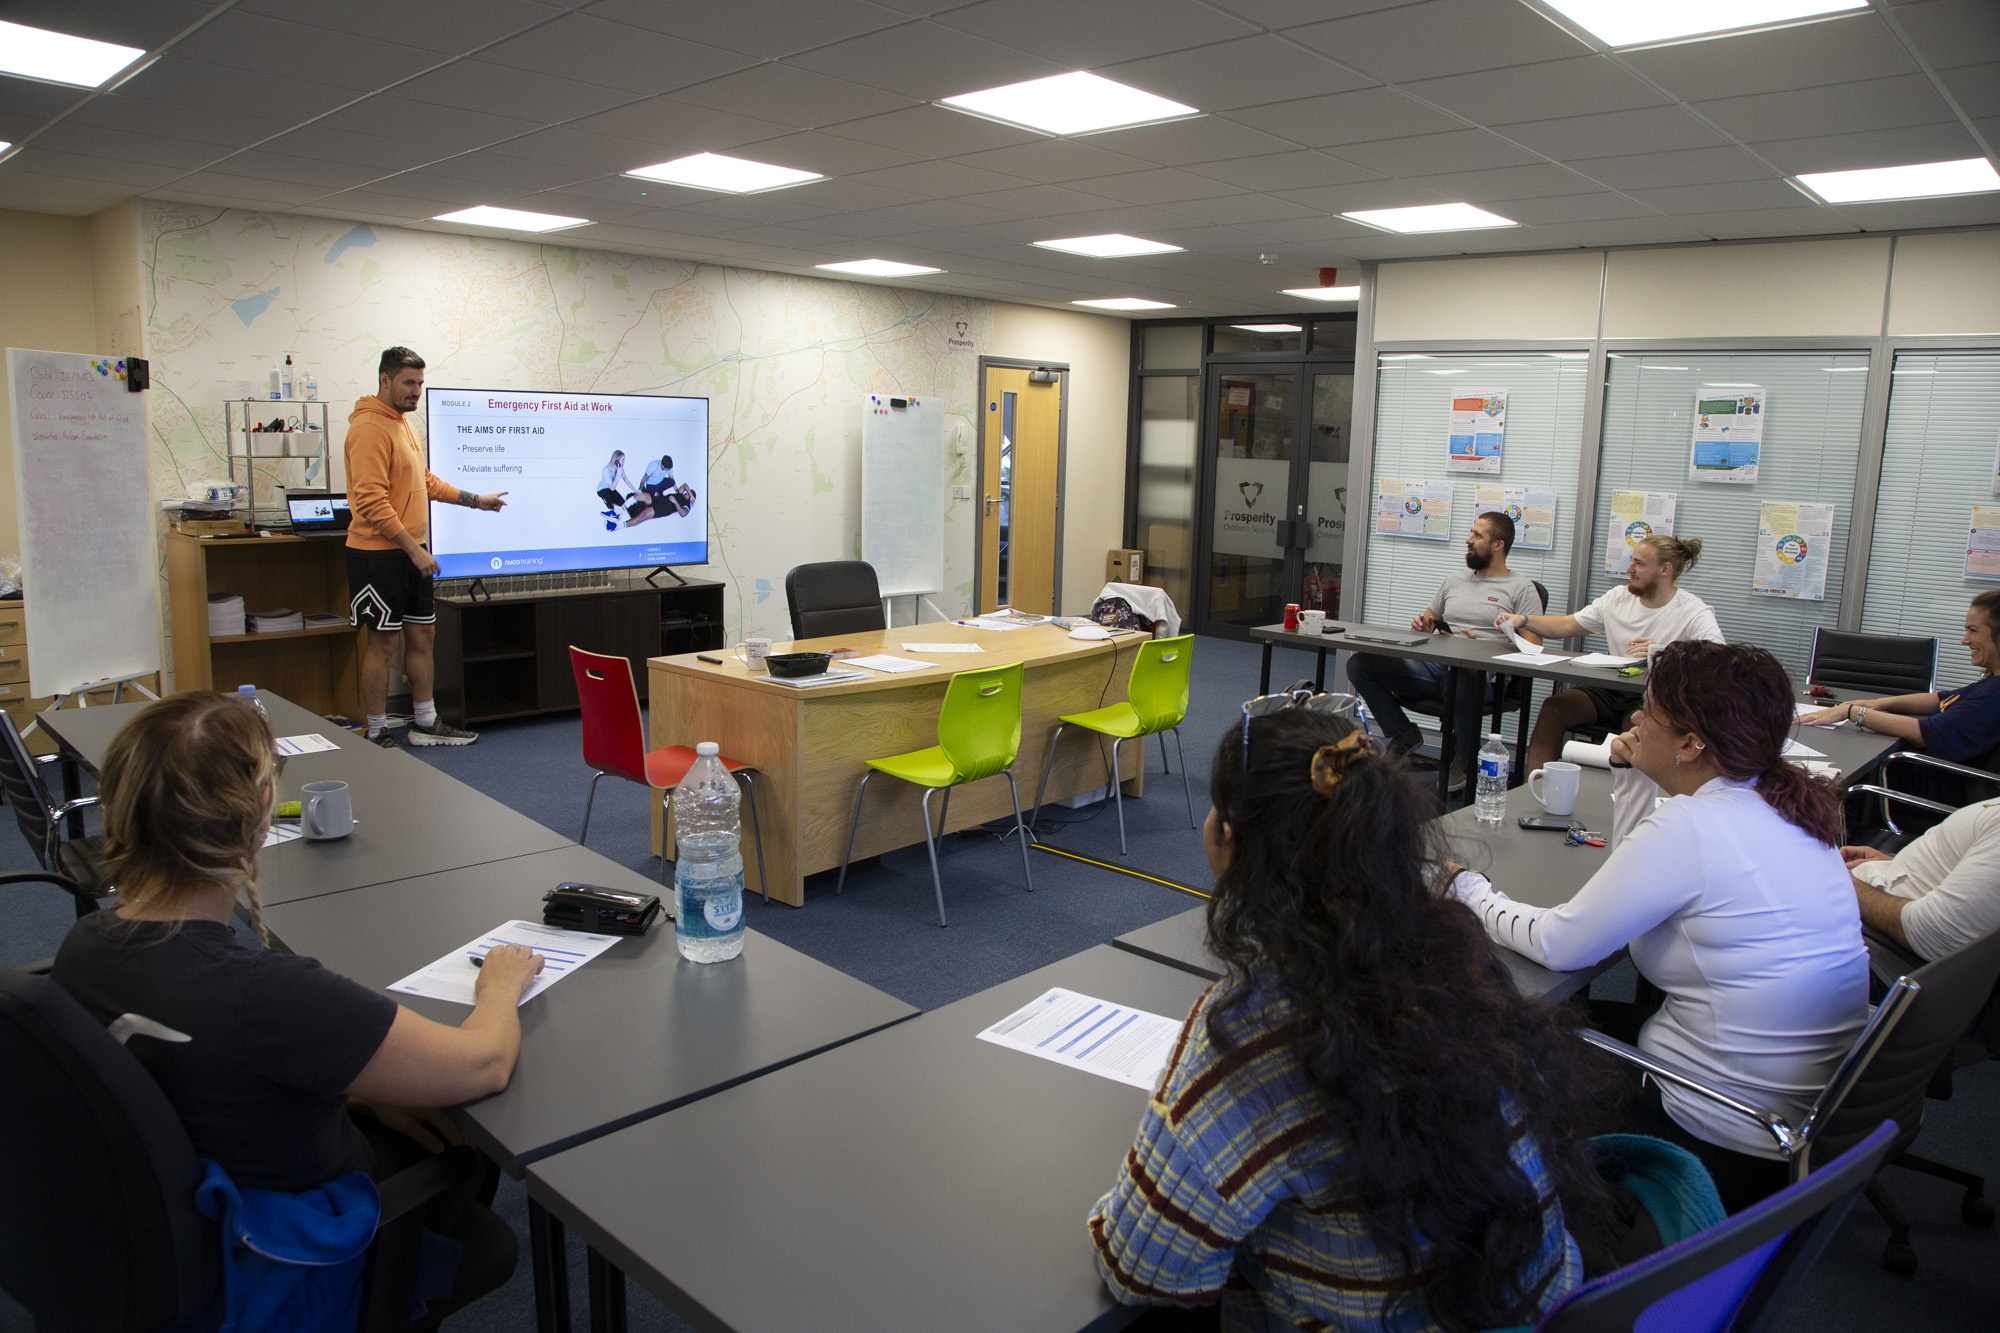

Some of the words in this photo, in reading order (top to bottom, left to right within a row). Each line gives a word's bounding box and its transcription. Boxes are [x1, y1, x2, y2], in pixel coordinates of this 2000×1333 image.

[948, 337, 974, 348] Prosperity
[488, 399, 539, 412] Emergency
[541, 400, 562, 411] First
[563, 400, 579, 411] Aid
[580, 402, 589, 411] at
[591, 401, 613, 412] Work
[457, 425, 472, 434] THE
[475, 426, 494, 434] AIMS
[496, 426, 507, 434] OF
[462, 444, 493, 453] Preserve
[494, 444, 505, 453] life
[462, 464, 492, 473] Alleviate
[493, 464, 523, 474] suffering
[1224, 510, 1276, 525] Prosperity
[1223, 523, 1250, 532] Children's
[1251, 525, 1275, 535] Services
